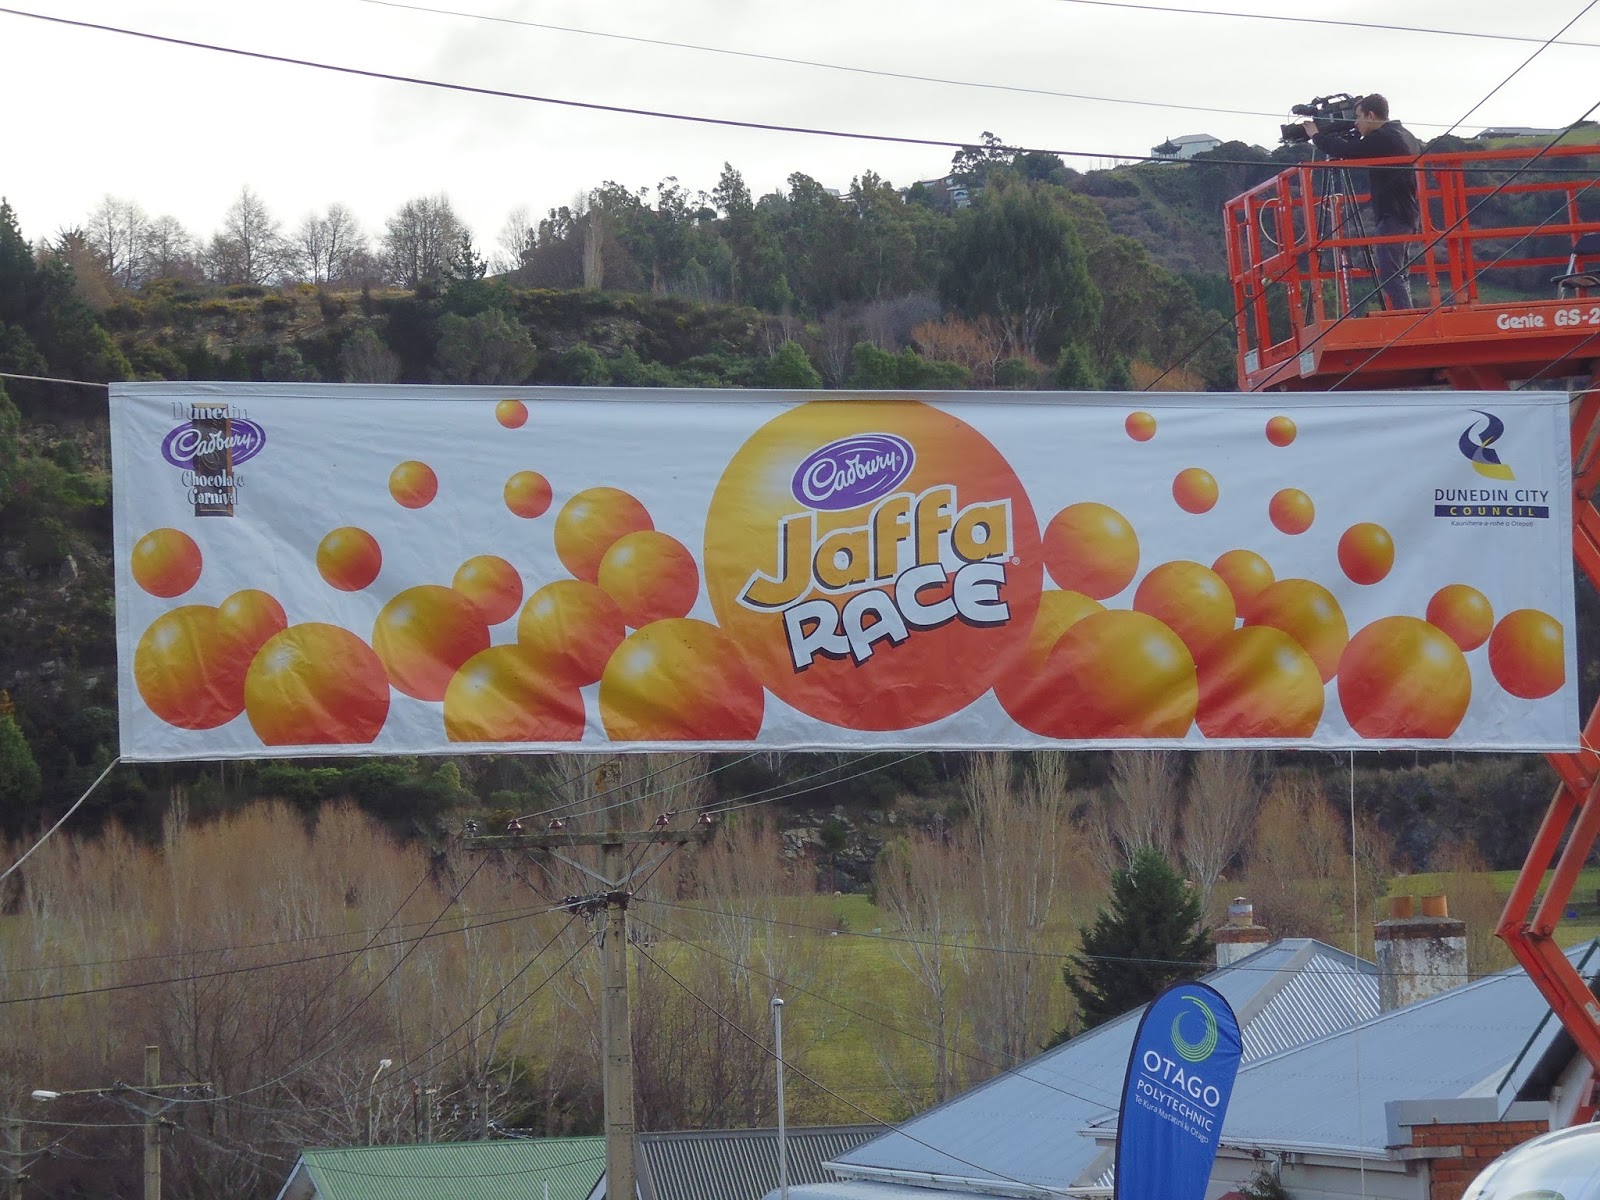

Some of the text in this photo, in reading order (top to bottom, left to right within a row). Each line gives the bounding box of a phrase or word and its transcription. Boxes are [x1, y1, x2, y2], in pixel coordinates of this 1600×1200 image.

[1497, 313, 1544, 329] Genie
[170, 428, 252, 461] Cadbury
[181, 468, 245, 488] Chocolate
[187, 486, 239, 505] Carnival
[802, 451, 897, 501] Cadbury
[1434, 488, 1549, 502] DUNEDIN CITY
[1449, 506, 1534, 517] COUNCIL
[736, 484, 1014, 612] Jaffa
[782, 562, 1011, 674] RACE
[1143, 1050, 1220, 1108] OTAGO
[1135, 1094, 1143, 1105] Te
[1142, 1100, 1158, 1113] Kura
[1190, 1127, 1209, 1144] Otago
[1137, 1080, 1214, 1132] POLYTECHNIC
